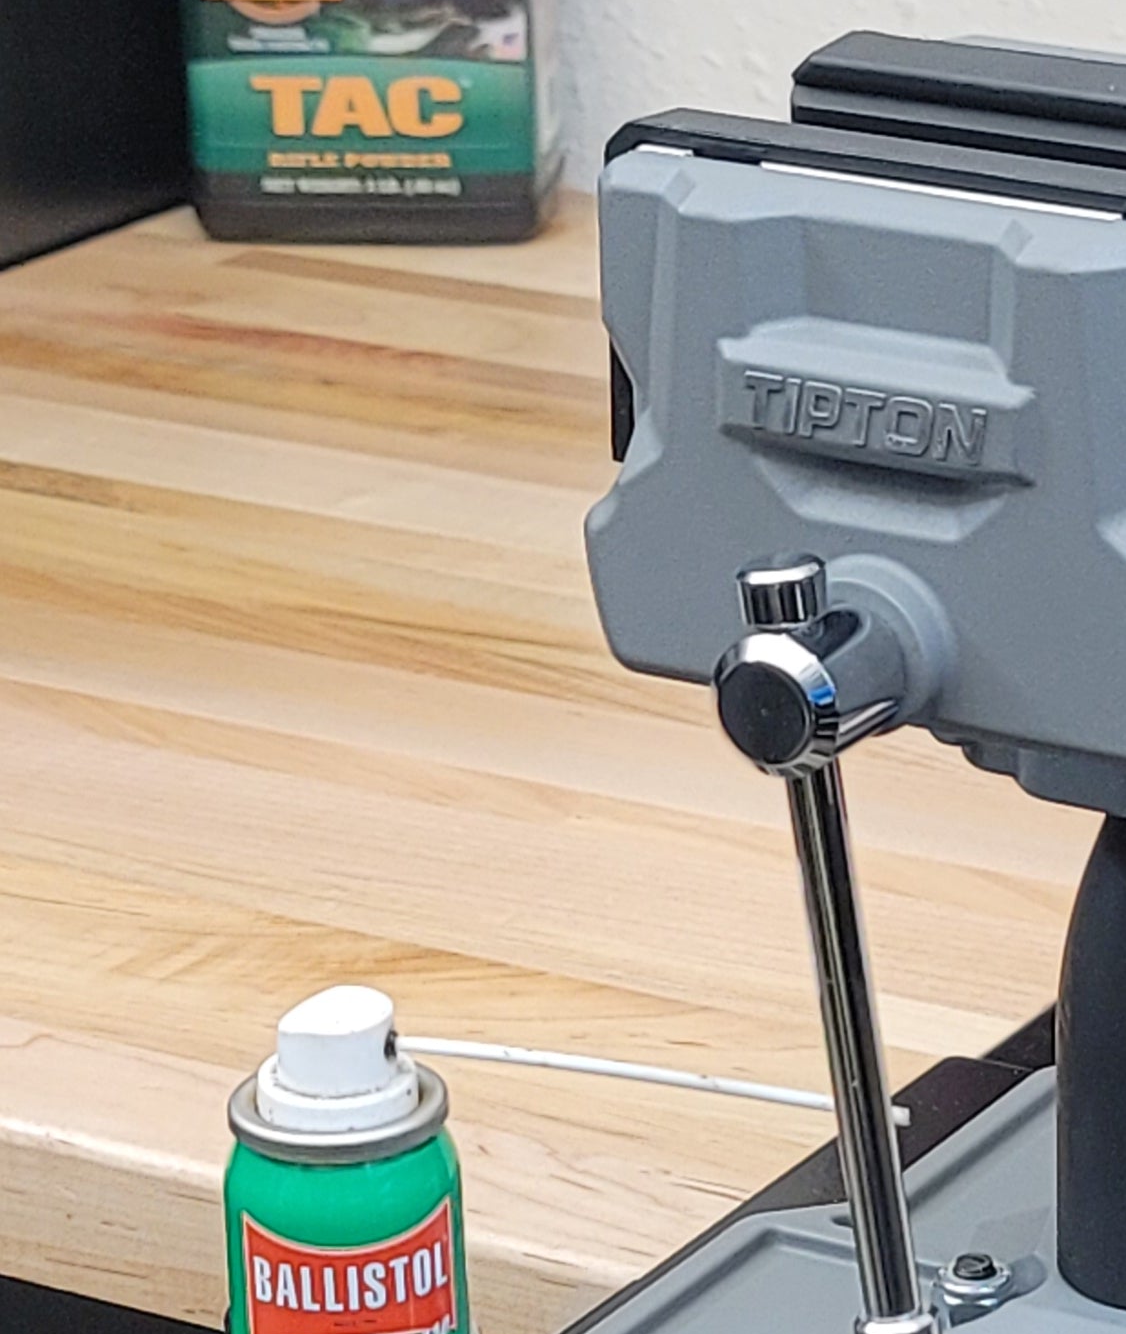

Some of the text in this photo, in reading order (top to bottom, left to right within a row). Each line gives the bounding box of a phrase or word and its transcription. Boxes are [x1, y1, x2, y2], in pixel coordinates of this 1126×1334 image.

[251, 75, 464, 138] TAC
[744, 370, 988, 467] TIPTON
[252, 1240, 449, 1313] BALLISTOL
